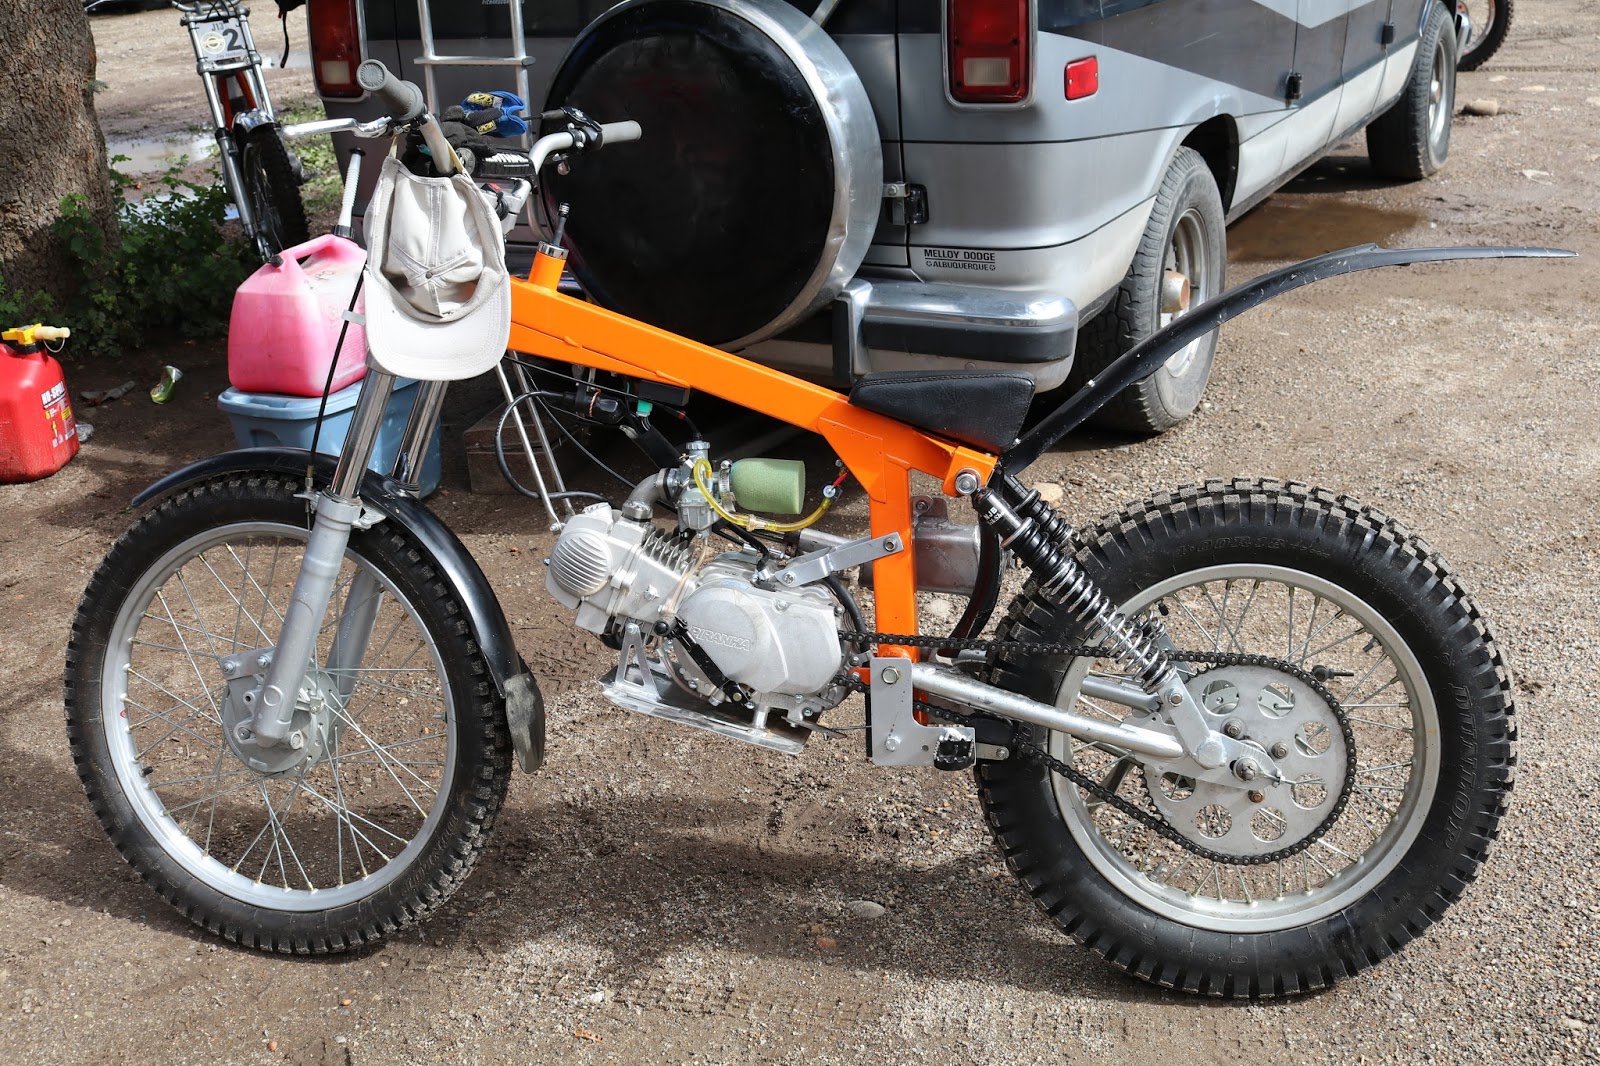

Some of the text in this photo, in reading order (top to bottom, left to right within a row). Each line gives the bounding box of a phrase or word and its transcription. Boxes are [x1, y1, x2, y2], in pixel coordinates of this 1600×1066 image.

[222, 28, 244, 51] 2
[924, 249, 996, 261] MELLOY DODGE
[933, 261, 989, 271] ALBUQUERQUE
[689, 625, 750, 652] PIRANHA
[1445, 683, 1478, 850] DUNLOP
